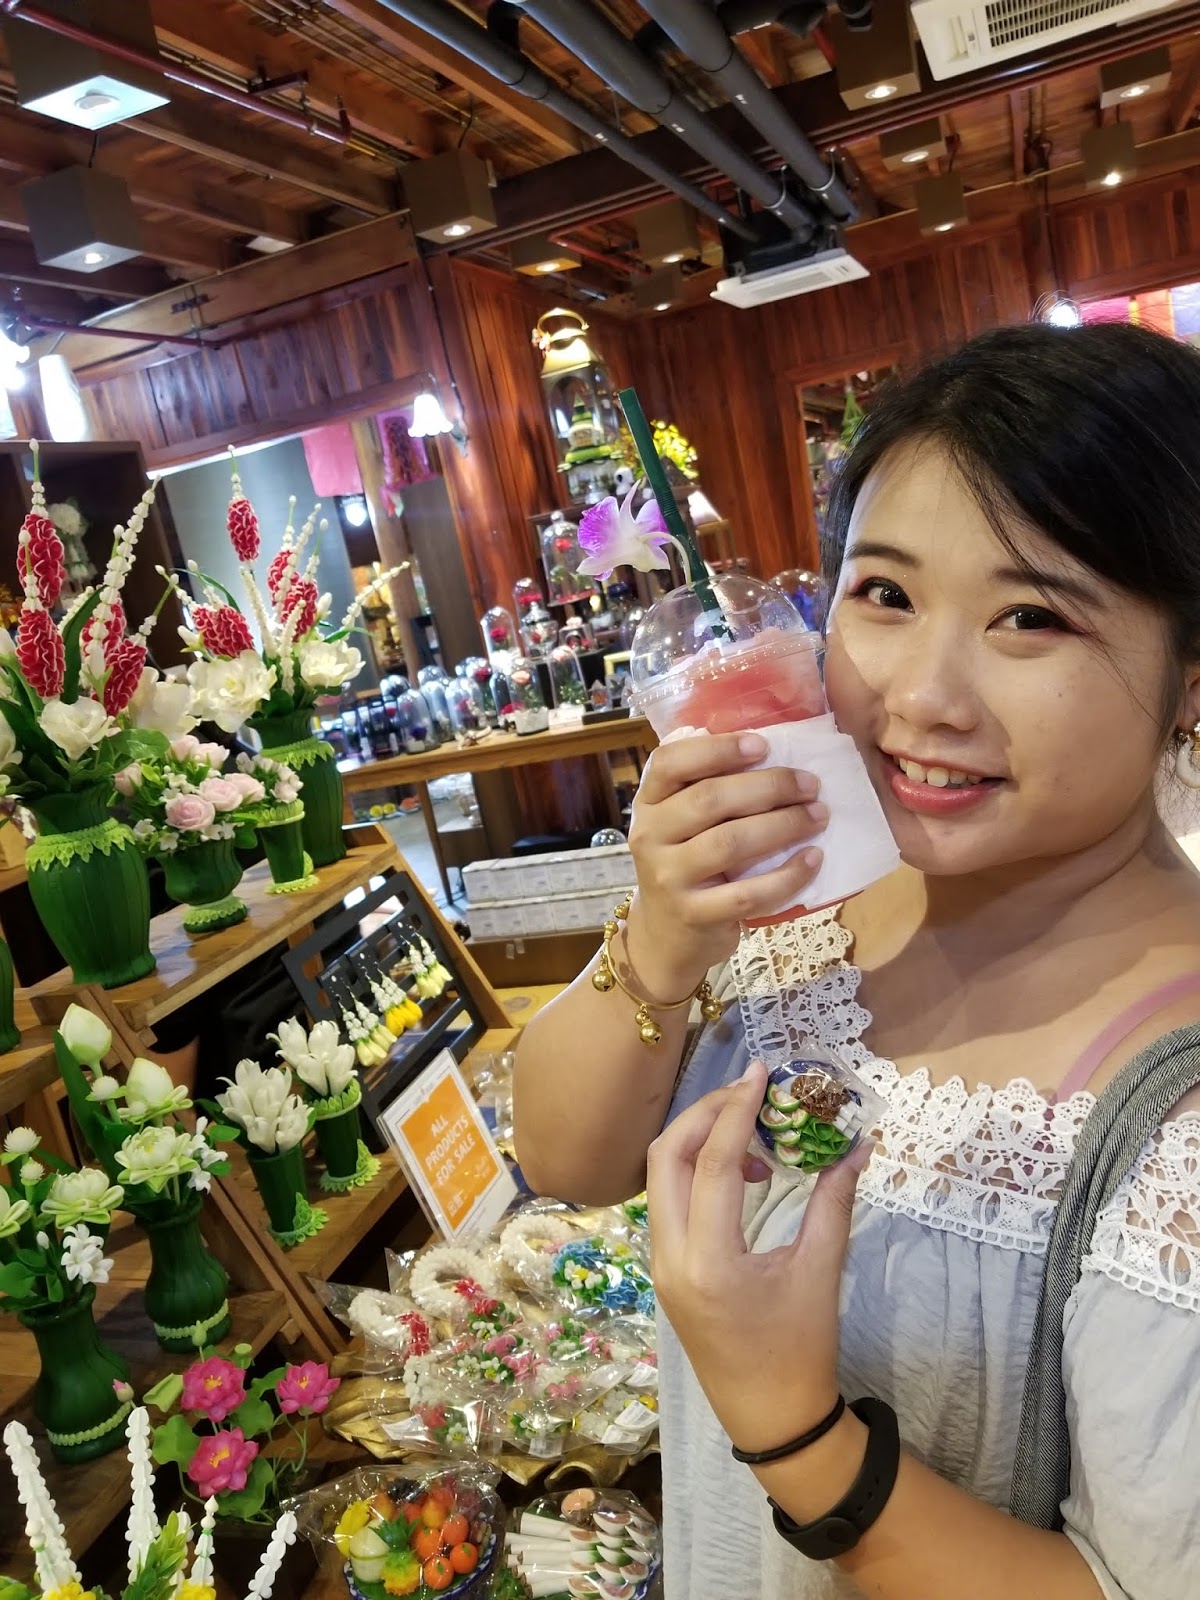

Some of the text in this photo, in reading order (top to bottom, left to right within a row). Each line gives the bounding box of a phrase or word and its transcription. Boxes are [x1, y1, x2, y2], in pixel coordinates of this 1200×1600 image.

[425, 1115, 469, 1170] PRODUCTS
[431, 1115, 449, 1137] ALL
[435, 1158, 456, 1186] FOR
[454, 1133, 476, 1162] SALE
